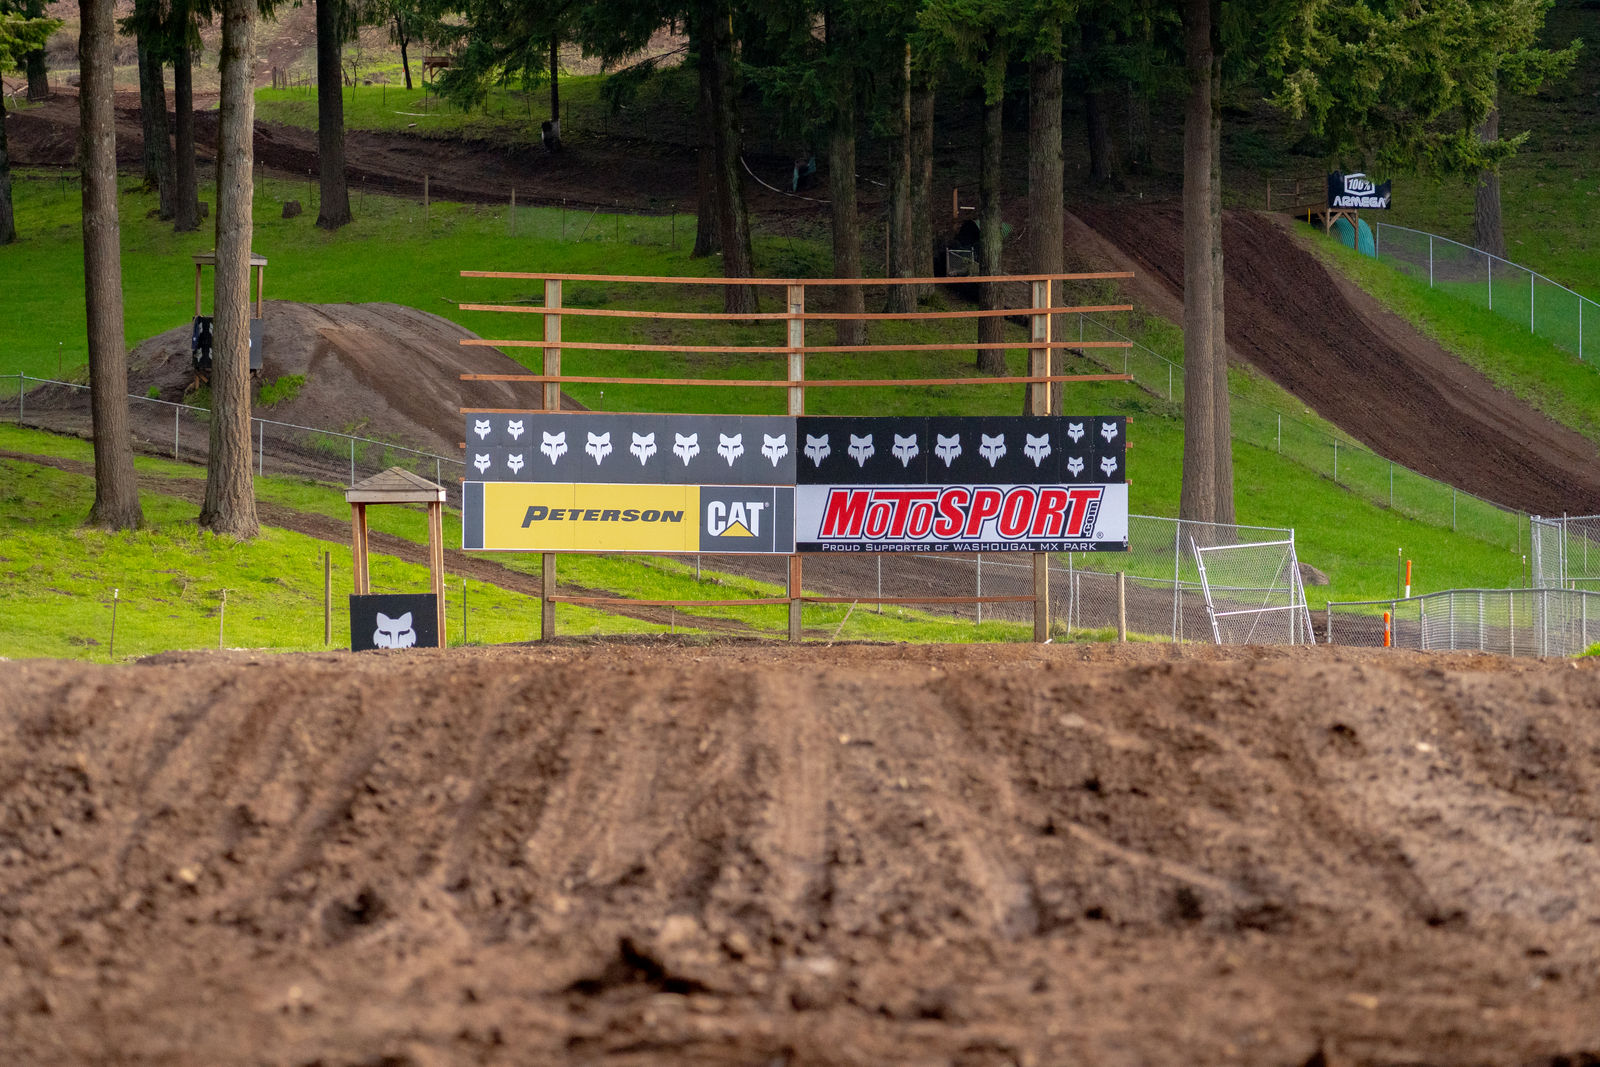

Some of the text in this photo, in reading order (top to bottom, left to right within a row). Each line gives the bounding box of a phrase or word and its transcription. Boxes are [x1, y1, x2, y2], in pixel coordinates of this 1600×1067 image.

[1348, 178, 1371, 191] 100%
[1333, 195, 1386, 208] ARMEGA
[521, 505, 684, 528] PETERSON
[707, 500, 764, 537] CAT
[822, 543, 1096, 552] PROUD SUPPORTER OF WASHOUGAL MX PARK
